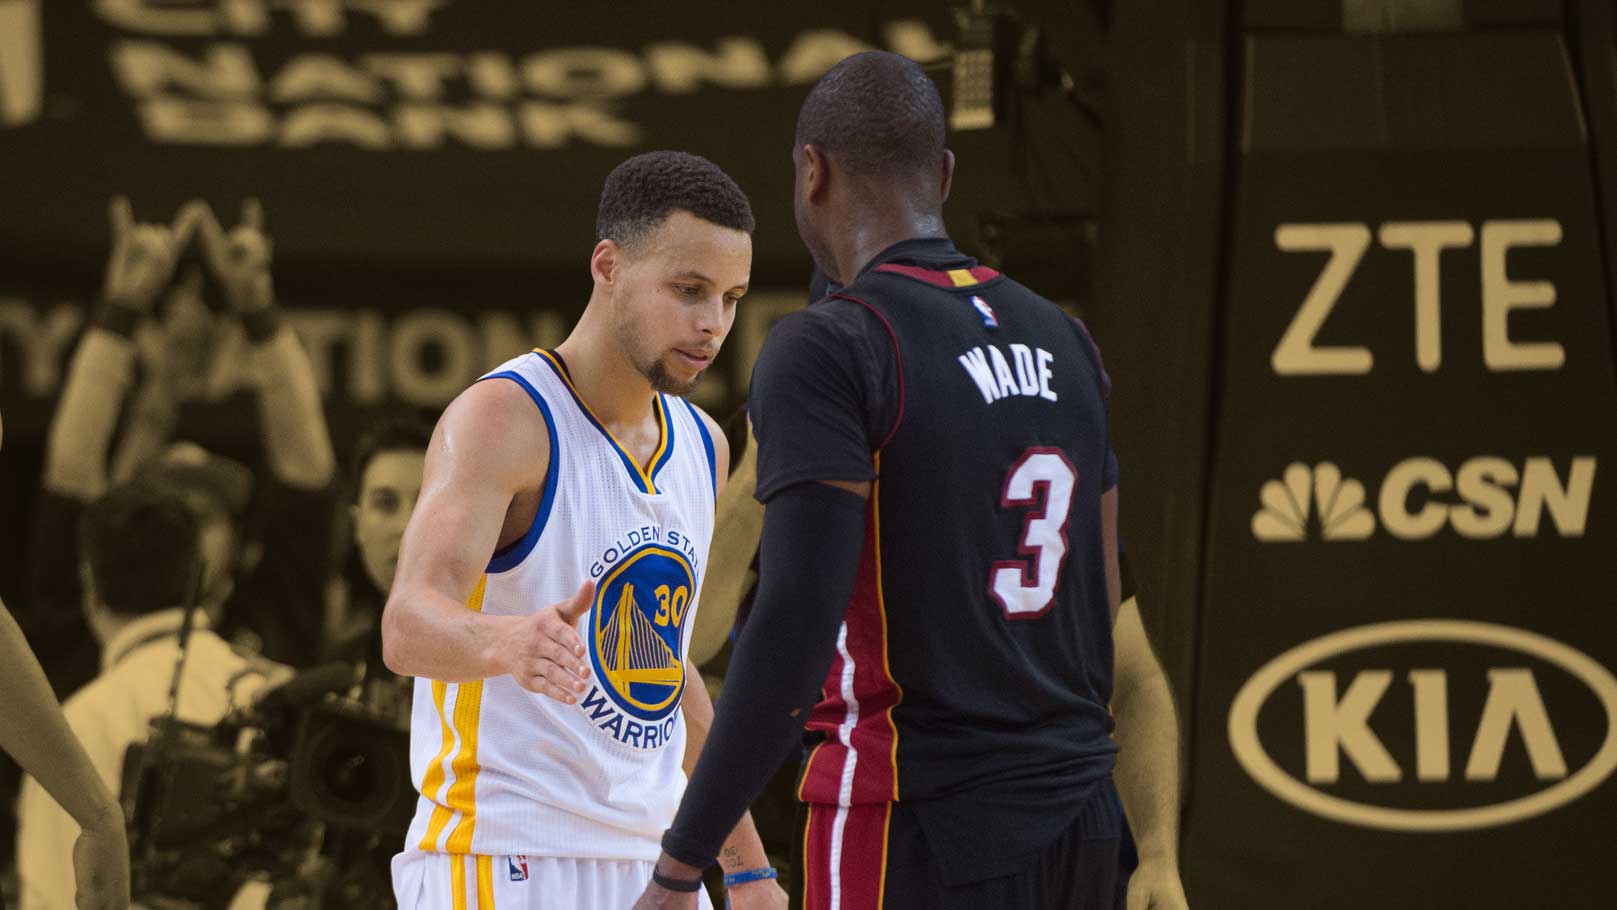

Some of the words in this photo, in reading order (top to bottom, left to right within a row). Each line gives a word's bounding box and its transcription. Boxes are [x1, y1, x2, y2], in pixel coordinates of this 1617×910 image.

[143, 98, 642, 148] BANK
[1271, 219, 1566, 376] ZTE
[957, 342, 1059, 404] WADE
[1377, 455, 1597, 541] CSN
[590, 525, 660, 579] GOLDEN
[988, 446, 1078, 621] 3
[653, 584, 688, 628] 30
[580, 684, 681, 749] WARRIO
[1298, 666, 1568, 784] KIA
